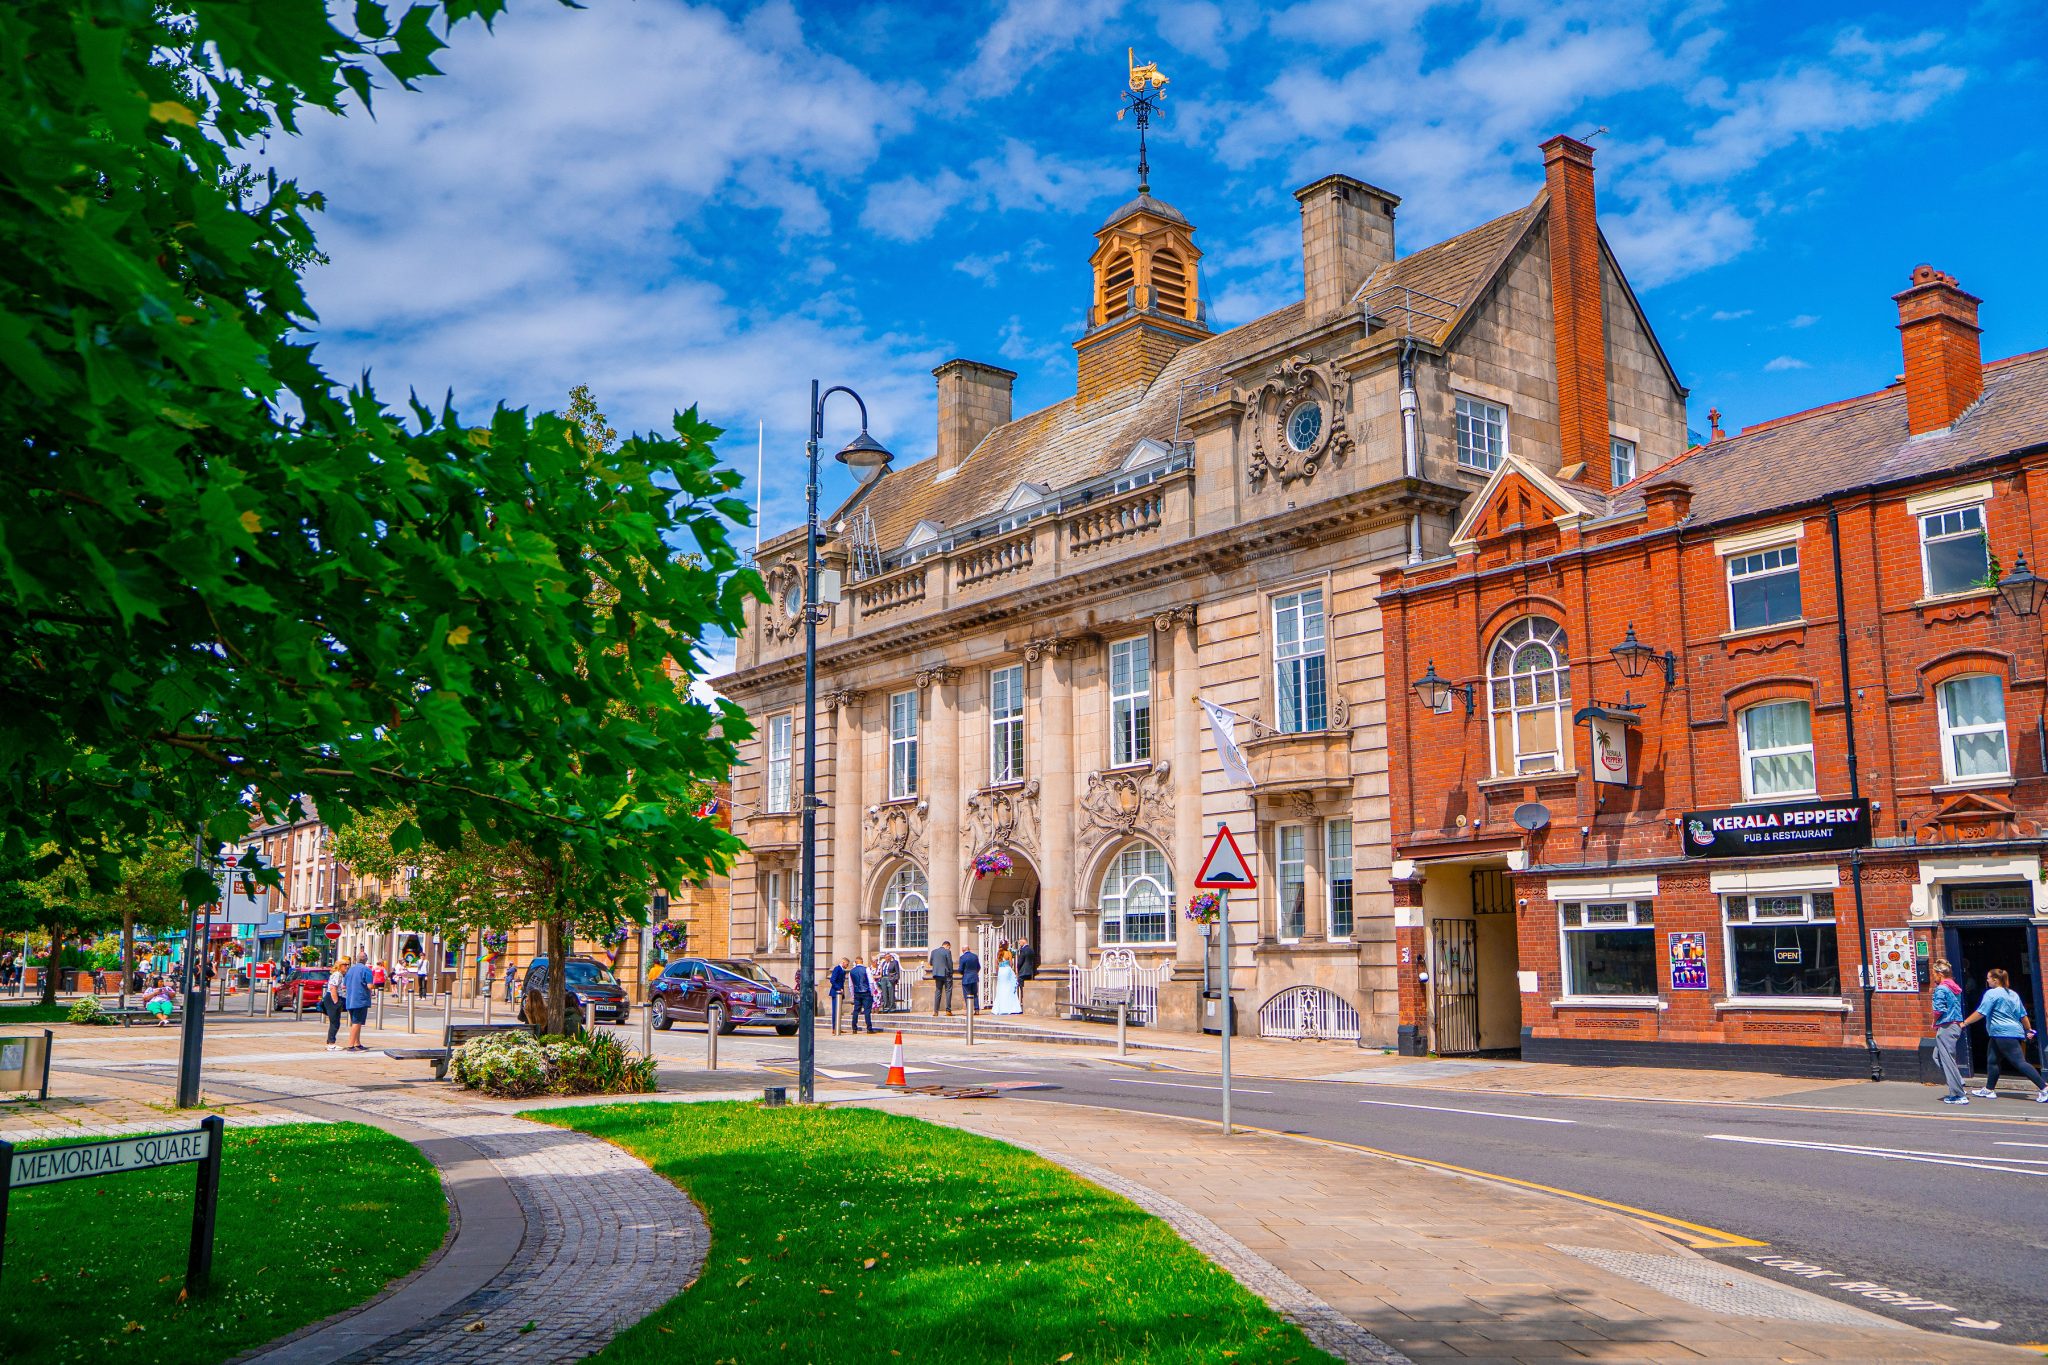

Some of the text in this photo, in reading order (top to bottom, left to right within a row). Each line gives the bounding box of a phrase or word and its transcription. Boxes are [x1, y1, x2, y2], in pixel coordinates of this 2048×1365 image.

[1712, 807, 1860, 831] KERALA PEPPERY
[1743, 828, 1833, 842] PUB & RESTAURANT
[1777, 952, 1798, 960] OPEN
[16, 1135, 202, 1182] MEMORIAL SQUARE
[1745, 1255, 1959, 1312] LOOK RIGHT
